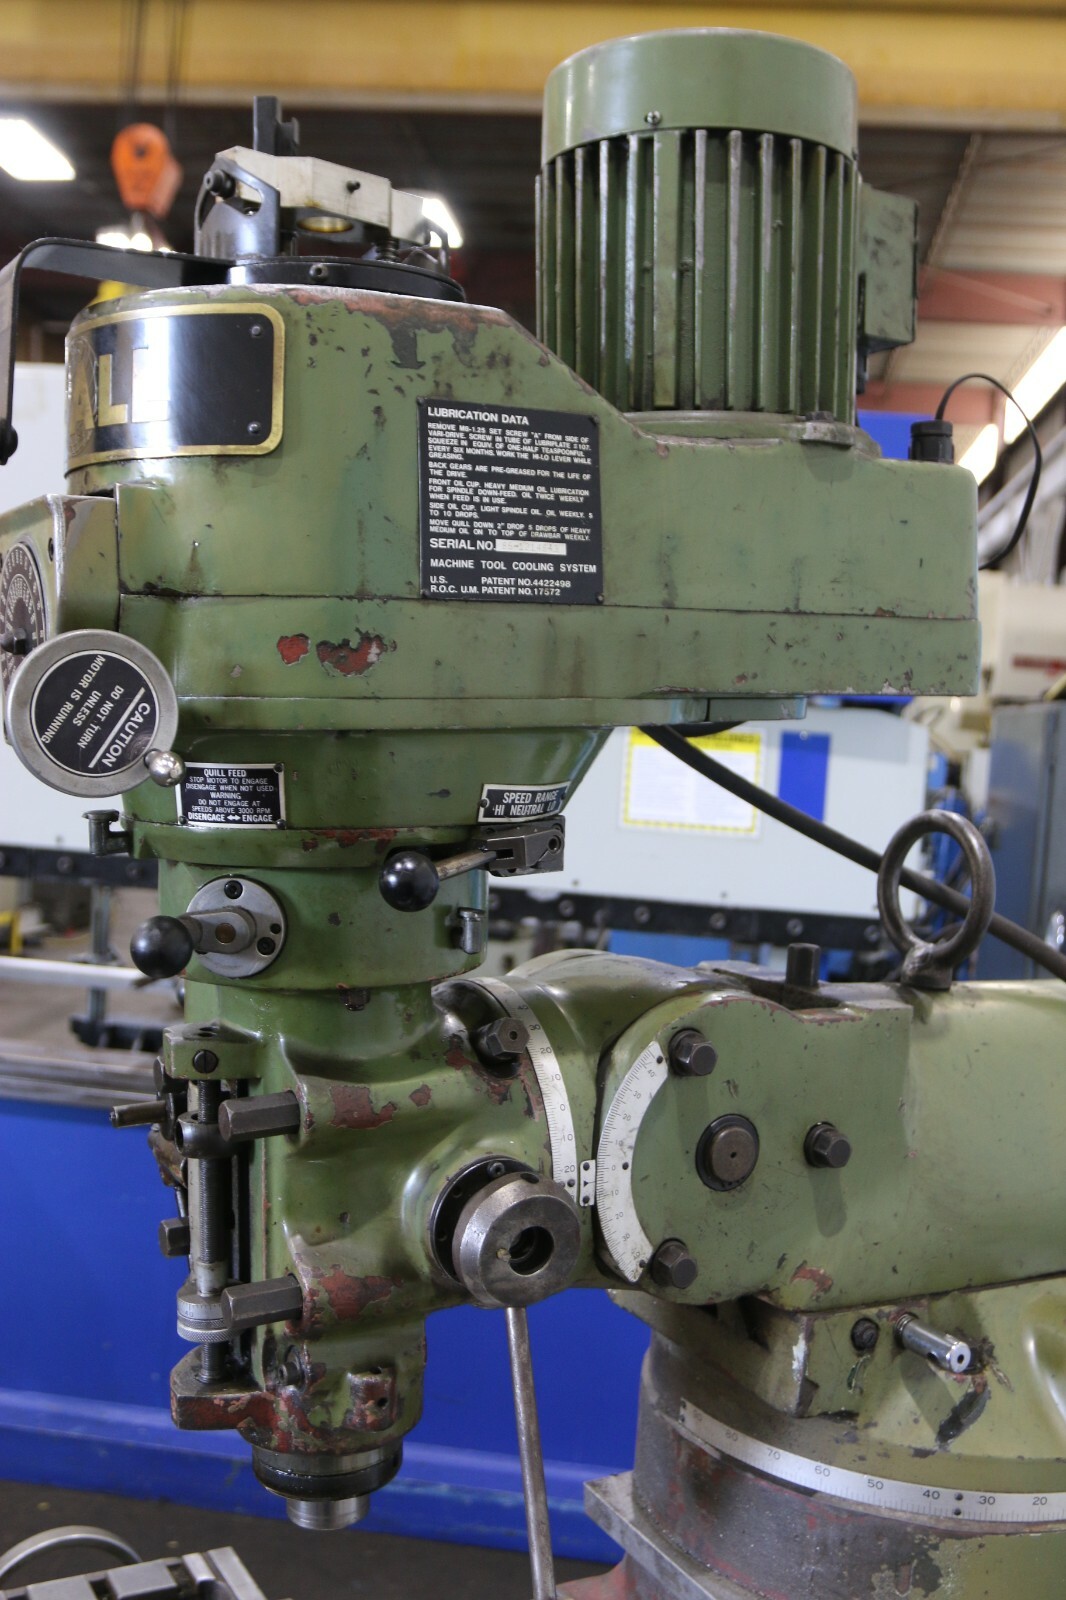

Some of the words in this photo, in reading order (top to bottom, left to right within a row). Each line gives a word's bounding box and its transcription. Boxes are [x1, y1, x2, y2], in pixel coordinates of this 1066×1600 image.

[427, 407, 499, 422] LUBRICATION
[501, 413, 530, 425] DATA
[428, 422, 456, 431] REMOVE
[505, 429, 528, 438] SCREW
[544, 433, 562, 441] FROM
[428, 437, 459, 446] SQUEEZE
[507, 444, 539, 453] ONE-HALF
[542, 447, 585, 457] TEASPOONFUL
[468, 433, 492, 442] SCREW
[534, 439, 570, 449] LUBRIPLATE
[428, 444, 450, 453] EVERY
[496, 450, 515, 458] WORK
[532, 453, 549, 461] HI-LO
[551, 454, 571, 463] LEVER
[573, 456, 592, 465] WHILE
[428, 461, 447, 469] BACK
[449, 463, 472, 471] GEARS
[491, 466, 536, 476] PRE-GREASED
[428, 478, 451, 486] FRONT
[484, 482, 506, 490] HEAVY
[509, 484, 534, 492] MEDIUM
[550, 487, 590, 496] LUBRICATION
[428, 485, 443, 493] FOR
[446, 486, 474, 495] SPINDLE
[535, 493, 555, 501] TWICE
[429, 493, 449, 501] WHEN
[452, 494, 470, 502] FEED
[429, 502, 444, 510] SIDE
[480, 505, 500, 513] LIGHT
[501, 506, 528, 515] SPINDLE
[429, 526, 456, 534] MEDIUM
[452, 520, 470, 528] QUILL
[473, 521, 494, 529] DOWN
[430, 538, 475, 550] SERIAL
[476, 540, 496, 551] NO.
[430, 558, 474, 568] MACHINE
[480, 560, 507, 570] TOOL
[512, 561, 554, 572] COOLING
[560, 563, 597, 573] SYSTEM
[481, 577, 515, 585] PATENT
[430, 585, 458, 593] R.O.C.
[461, 586, 479, 594] U.M.
[481, 586, 516, 594] PATENT
[78, 655, 106, 689] MOTOR
[70, 690, 83, 701] IS
[110, 685, 125, 700] DO
[72, 690, 102, 727] UNLESS
[95, 702, 114, 722] NOT
[40, 701, 74, 744] RUNNING
[77, 725, 100, 749] TURN
[101, 702, 151, 768] CAUTION
[204, 768, 226, 777] QUILL
[228, 769, 247, 777] FEED
[186, 783, 216, 791] DISENGAGE
[502, 792, 532, 804] SPEED
[535, 790, 559, 803] RANGE
[494, 805, 504, 816] HI
[510, 803, 544, 816] NEUTRAL
[547, 801, 557, 812] LO
[188, 812, 226, 821] DISENGAGE
[647, 1069, 655, 1077] 40
[633, 1090, 641, 1099] 30
[622, 1113, 631, 1121] 20
[563, 1134, 573, 1142] 10
[564, 1165, 575, 1173] 20
[615, 1211, 623, 1220] 20
[622, 1233, 630, 1242] 30
[767, 1448, 781, 1460] 70
[814, 1465, 831, 1477] 60
[867, 1479, 884, 1490] 50
[923, 1489, 941, 1500] 40
[978, 1496, 996, 1505] 30
[1032, 1496, 1047, 1506] 20
